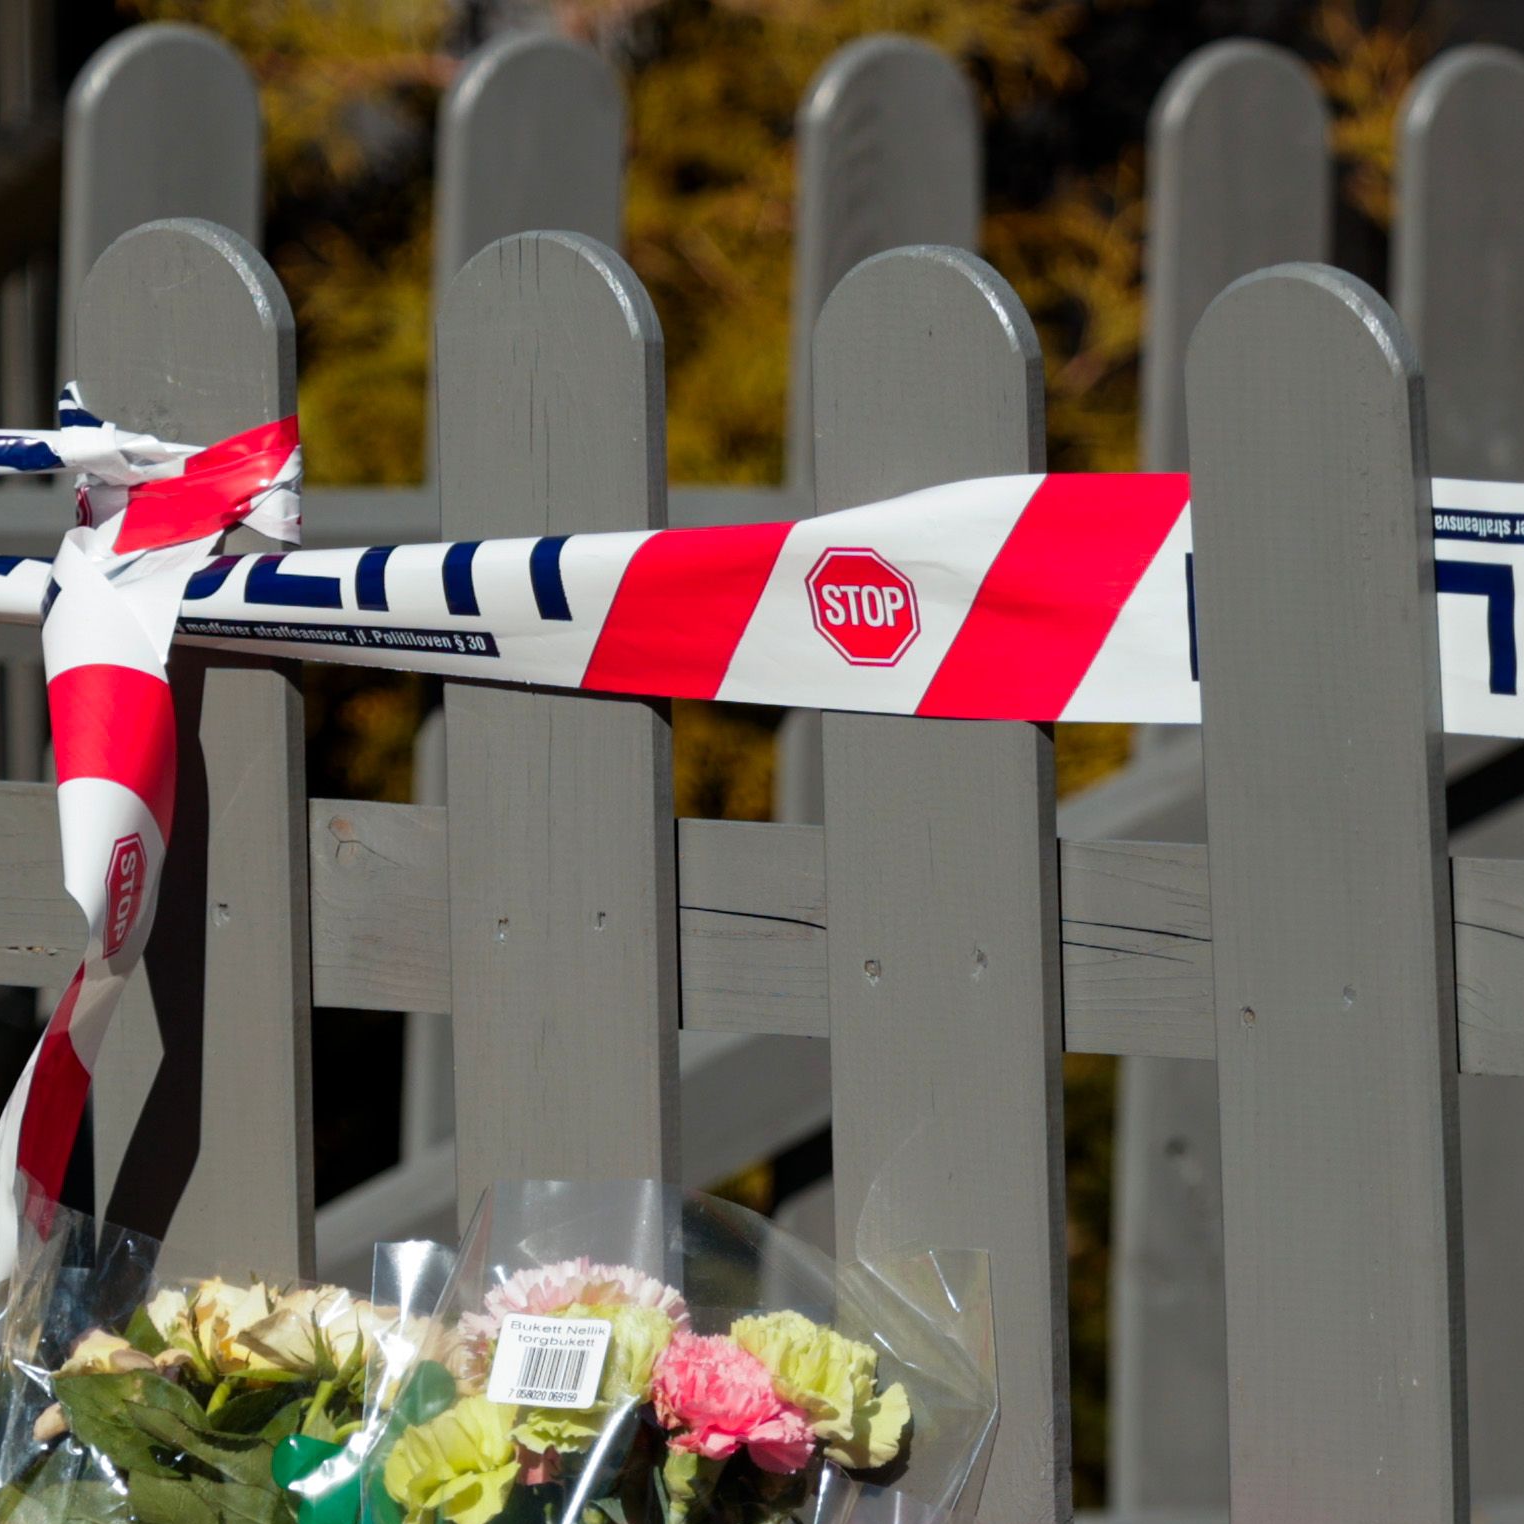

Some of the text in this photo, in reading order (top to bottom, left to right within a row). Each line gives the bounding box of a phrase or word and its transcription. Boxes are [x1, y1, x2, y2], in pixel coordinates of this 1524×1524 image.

[821, 584, 905, 627] STOP
[186, 620, 251, 636] medfører
[372, 630, 452, 649] Politiloven
[467, 635, 487, 651] 30
[114, 850, 137, 941] STOP
[511, 1320, 607, 1336] Bukett Nellik
[518, 1334, 595, 1347] torgbukett
